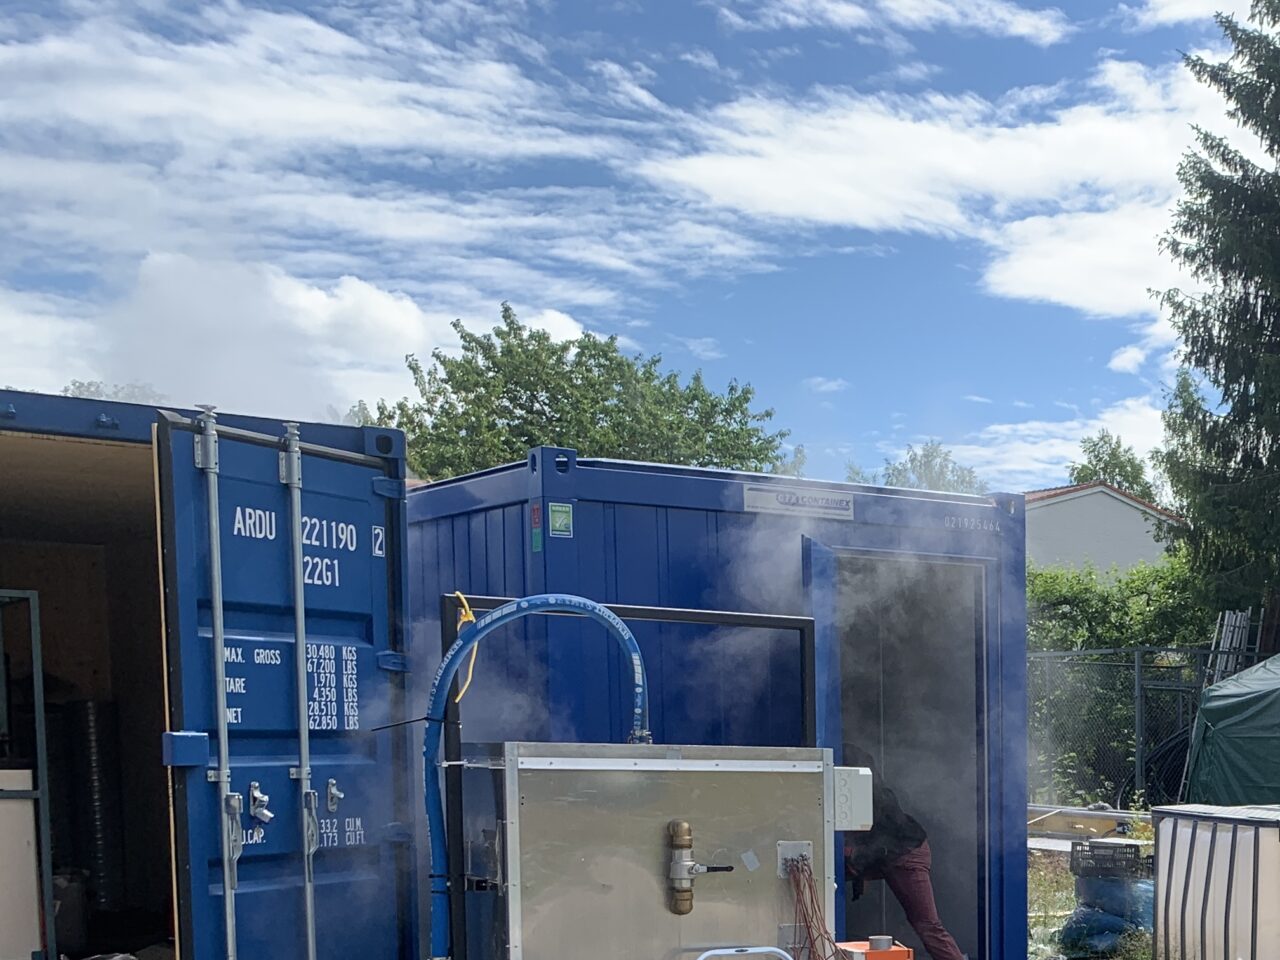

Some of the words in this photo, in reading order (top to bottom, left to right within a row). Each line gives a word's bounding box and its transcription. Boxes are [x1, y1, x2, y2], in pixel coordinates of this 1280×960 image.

[801, 495, 851, 507] CONTAINEX
[233, 506, 276, 540] ARDU
[301, 516, 357, 551] 221190
[373, 527, 384, 556] 2
[303, 555, 340, 587] 22G1
[224, 647, 246, 663] MAX.
[254, 649, 281, 665] GROSS
[306, 644, 336, 659] 30.480
[342, 646, 357, 660] KGS
[307, 658, 336, 673] 67.200
[342, 661, 357, 674] LBS
[225, 677, 246, 693] TARE
[313, 673, 336, 687] 1.970
[343, 674, 358, 688] KGS
[313, 687, 337, 701] 4.350
[343, 688, 358, 702] LBS
[226, 708, 242, 723] NET
[308, 702, 337, 716] 28.510
[344, 702, 359, 716] KGS
[309, 716, 338, 730] 62.850
[344, 716, 359, 730] LBS
[320, 818, 338, 833] 33.2
[320, 832, 338, 847] .173
